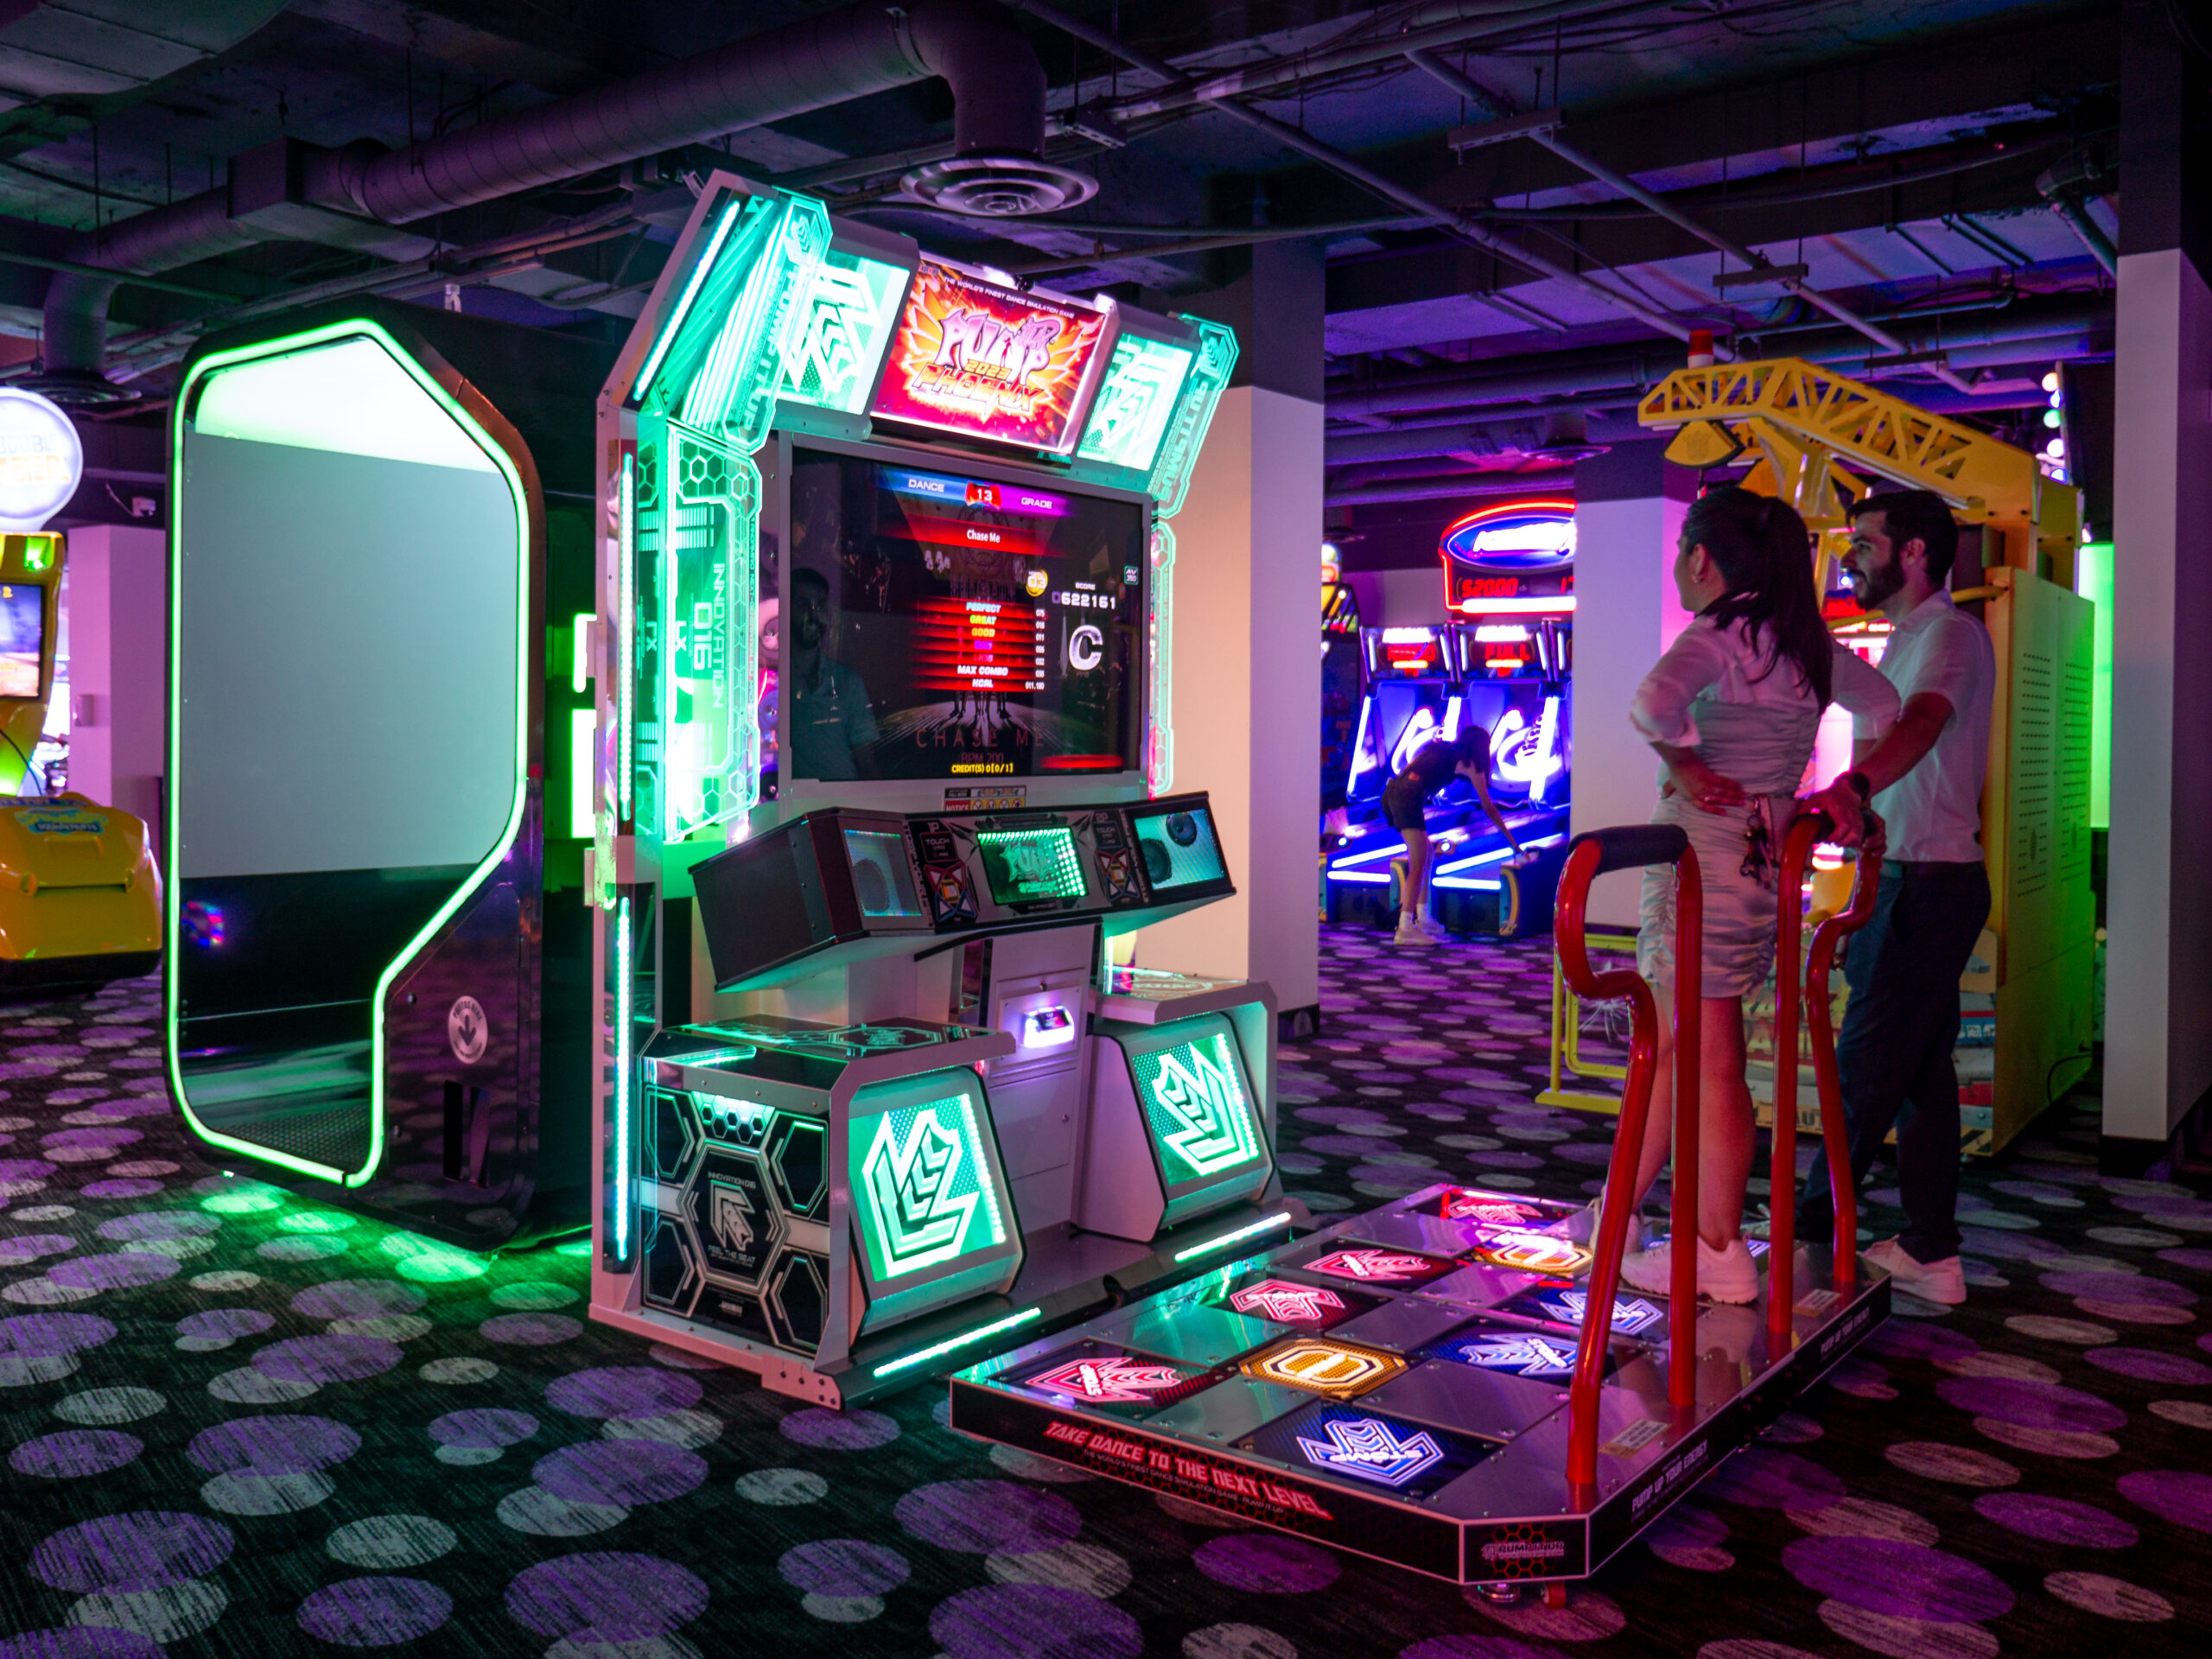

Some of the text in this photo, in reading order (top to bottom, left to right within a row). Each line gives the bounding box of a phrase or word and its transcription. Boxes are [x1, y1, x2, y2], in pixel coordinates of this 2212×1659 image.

[944, 276, 1074, 319] THE WORLD'S FINEST DANCE SIMULATION GAME
[934, 308, 1050, 385] PUMP
[964, 359, 1012, 379] 2023
[912, 363, 1044, 411] PHOENIX
[908, 479, 1052, 509] DANCE 13 GRADE
[967, 529, 1001, 543] Chase Me
[1028, 576, 1046, 588] 03
[966, 601, 1001, 613] PERFECT
[1052, 591, 1116, 610] 0622161
[969, 614, 997, 625] GREAT
[693, 602, 713, 671] 016
[712, 563, 725, 709] INNOVATION
[971, 627, 995, 637] GOOD
[1069, 624, 1103, 671] C
[1485, 644, 1530, 661] FULL
[957, 664, 977, 675] MAX
[978, 666, 1008, 677] COMBO
[972, 678, 994, 688] KCAL
[916, 728, 1044, 747] CHASE ME
[961, 752, 1004, 764] BPM 200
[951, 764, 985, 774] CREDIT(S)
[708, 1172, 744, 1187] INNOVATION
[724, 1248, 737, 1258] THE
[739, 1251, 756, 1265] BEAT
[1329, 1450, 1424, 1462] STOMP
[1044, 1421, 1090, 1446] TAKE
[1149, 1449, 1170, 1470] TO
[1175, 1457, 1209, 1481] THE
[1260, 1481, 1333, 1521] LEVEL
[1632, 1440, 1707, 1513] PUMP UP YOUR ENERGY
[1084, 1449, 1284, 1514] THE WORLD'S FINEST DANCE SIMULATION GAME PUMP IT UP
[1497, 1541, 1532, 1554] PUMP
[1546, 1540, 1565, 1551] UP
